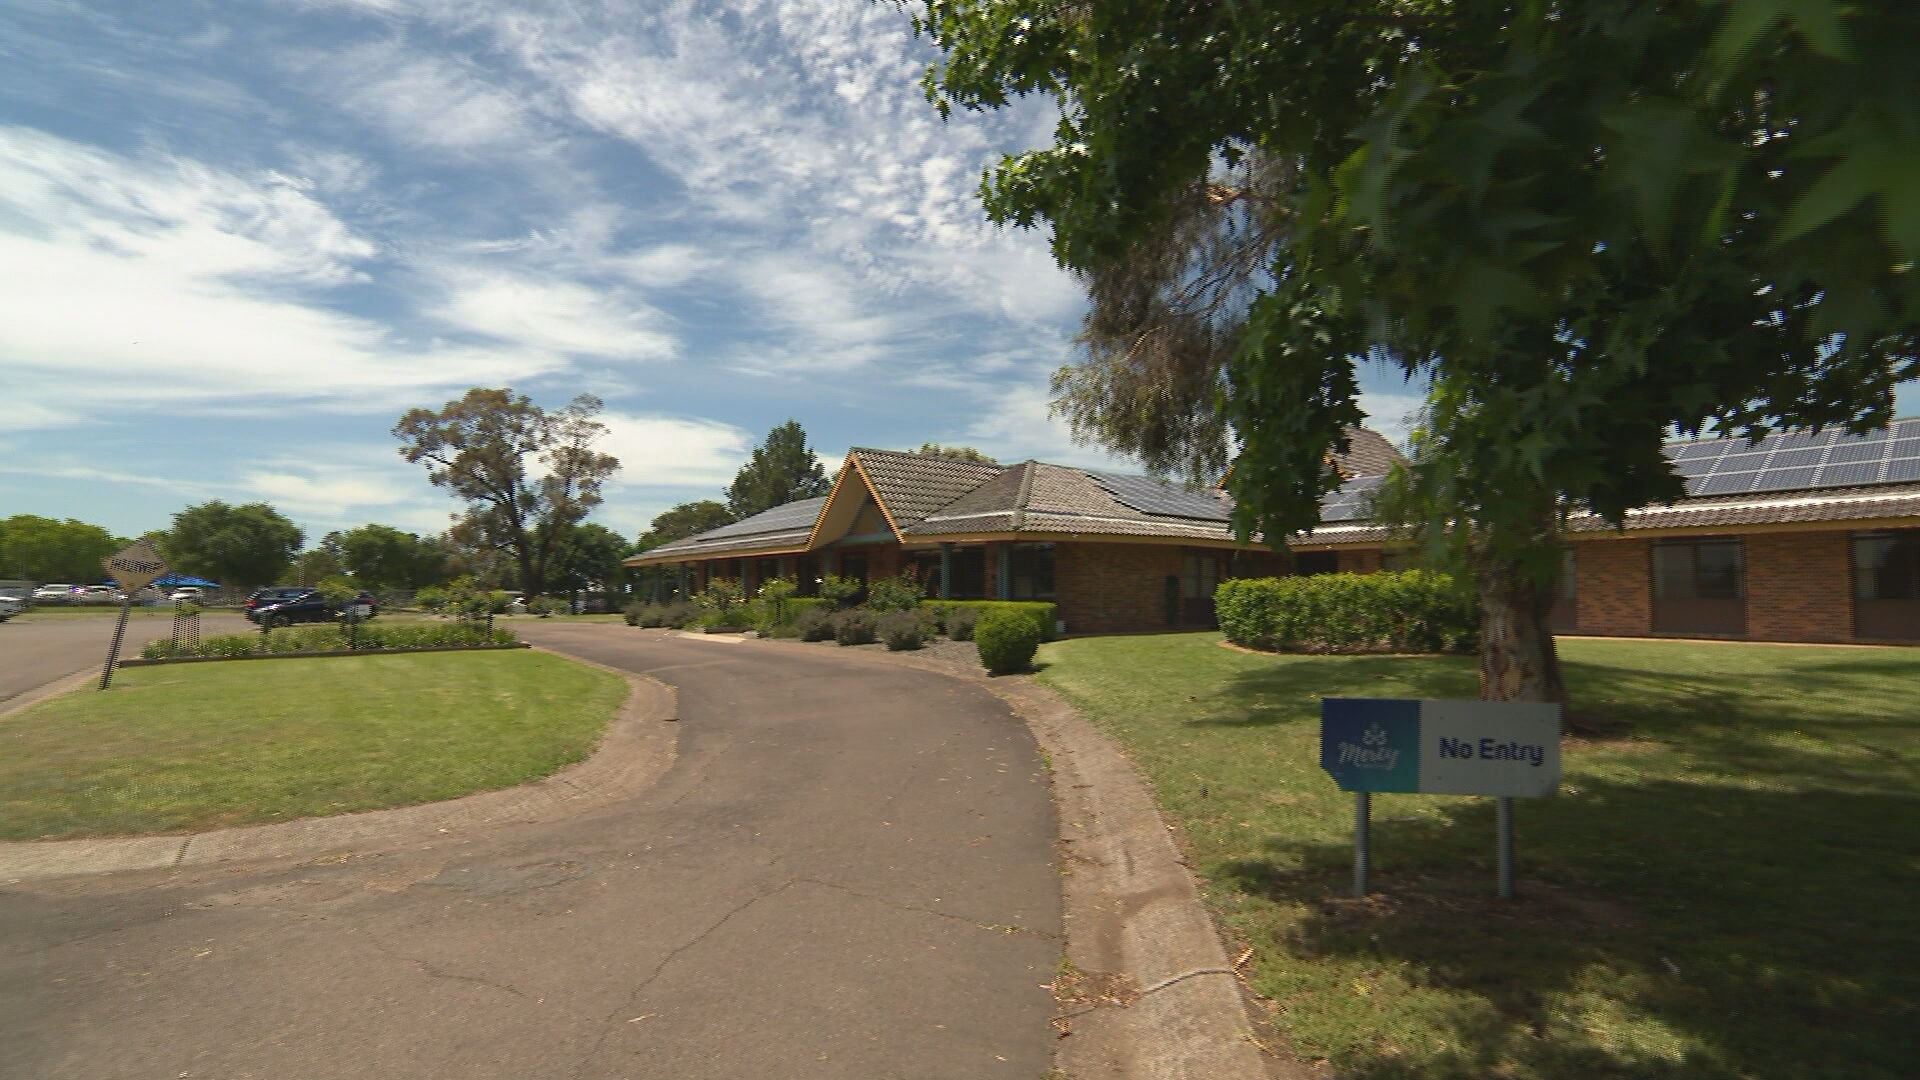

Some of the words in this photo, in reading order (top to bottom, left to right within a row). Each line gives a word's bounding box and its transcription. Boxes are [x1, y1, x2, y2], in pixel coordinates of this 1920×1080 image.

[110, 558, 163, 574] HUMP
[1338, 742, 1400, 771] Mercy
[1440, 737, 1474, 760] No
[1479, 738, 1544, 767] Entry
